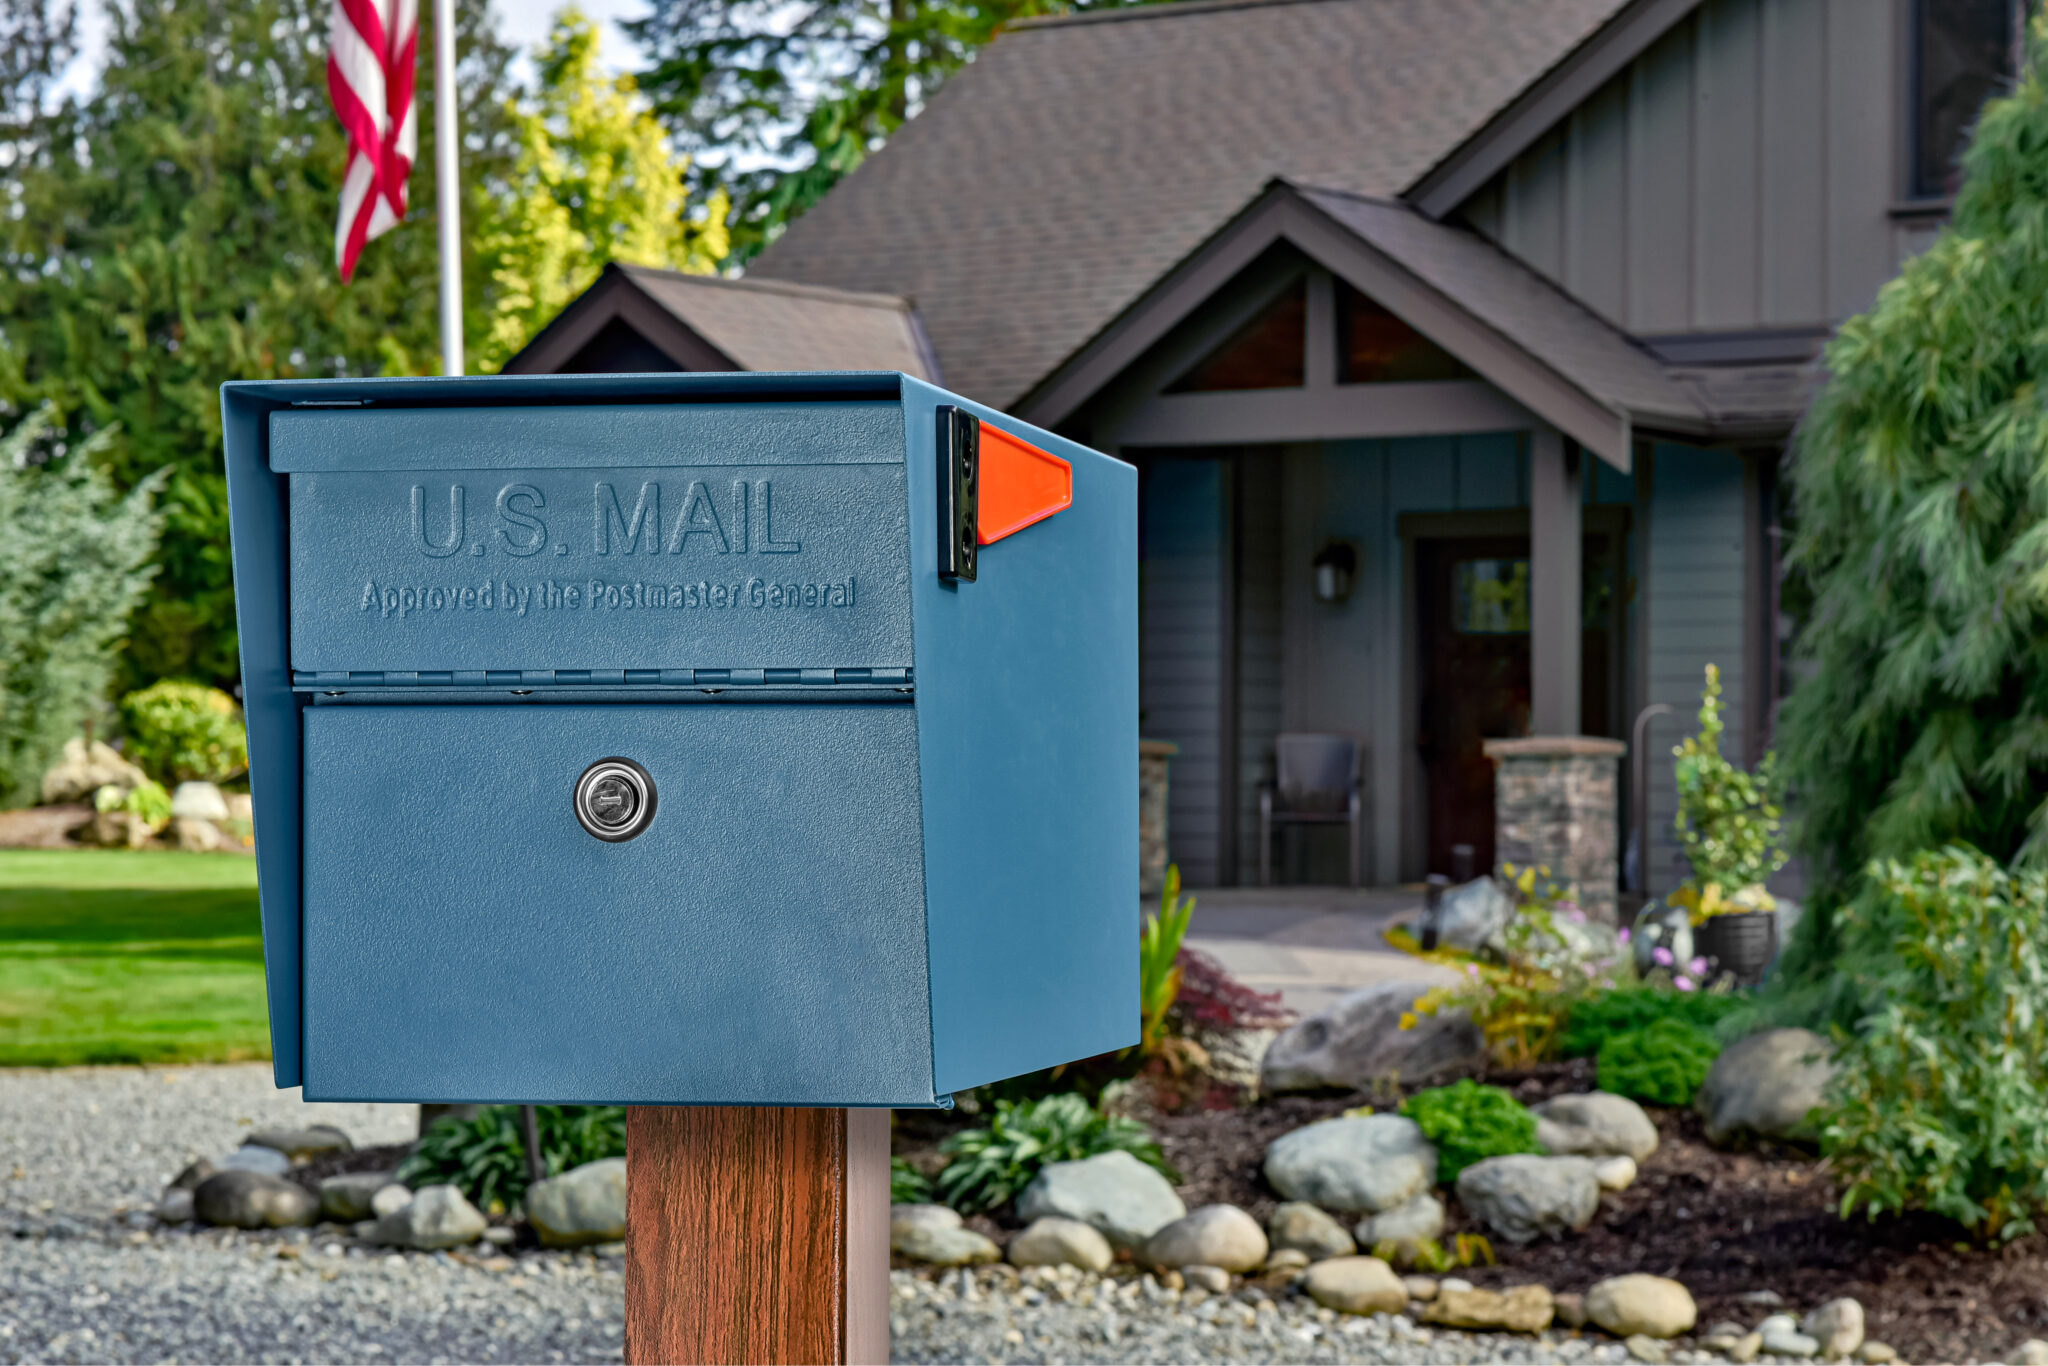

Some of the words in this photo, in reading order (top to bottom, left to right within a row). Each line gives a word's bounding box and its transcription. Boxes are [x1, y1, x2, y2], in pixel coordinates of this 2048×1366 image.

[411, 484, 568, 558] U.S.
[594, 481, 801, 555] MAIL
[360, 580, 494, 618] Approved
[501, 578, 532, 617] by
[537, 578, 580, 610] the
[588, 578, 741, 609] Postmaster
[748, 576, 857, 609] General
